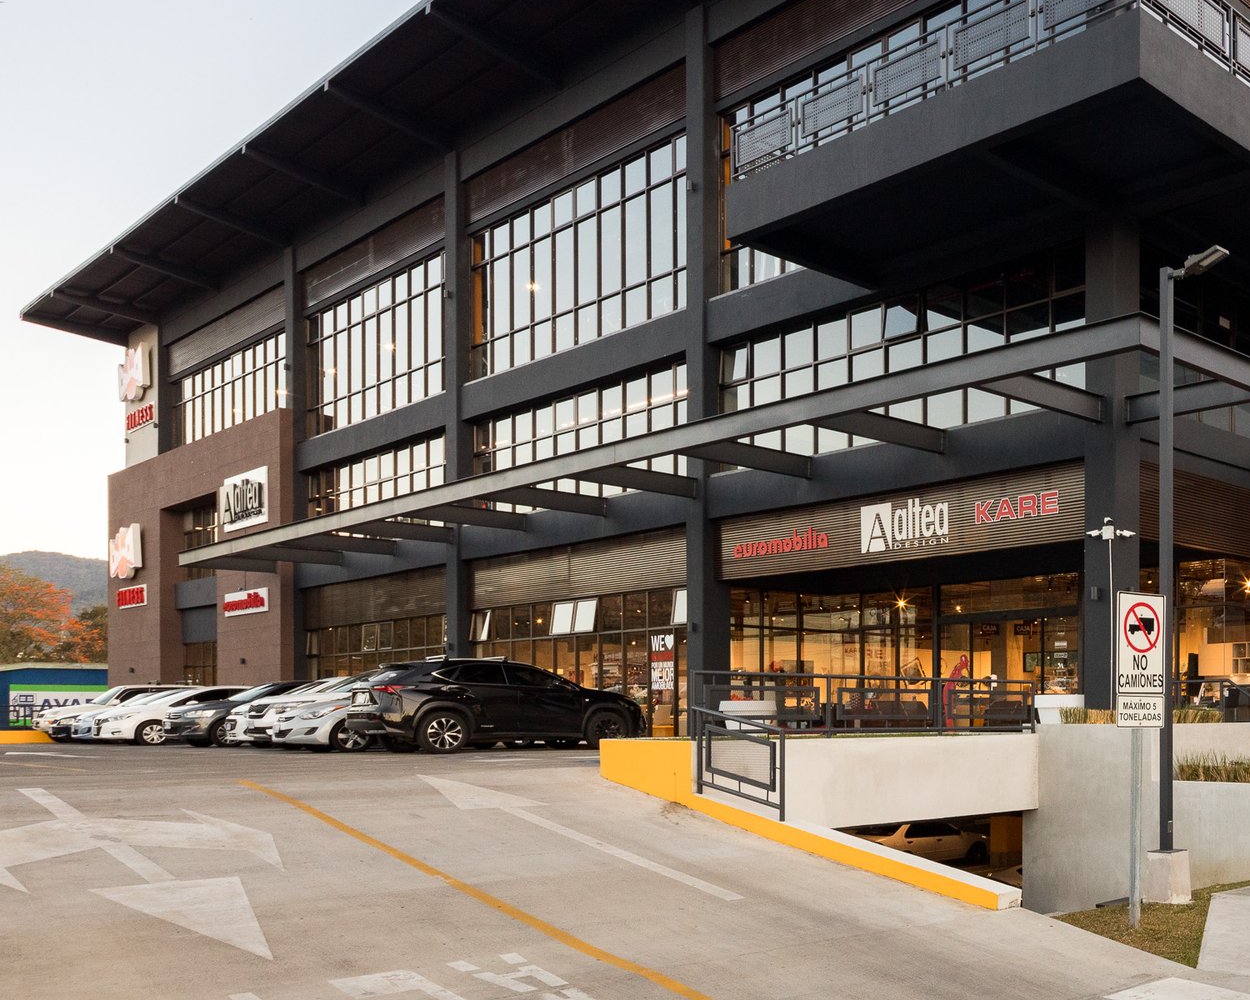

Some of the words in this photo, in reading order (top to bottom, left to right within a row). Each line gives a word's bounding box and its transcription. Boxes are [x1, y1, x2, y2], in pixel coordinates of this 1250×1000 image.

[975, 490, 1058, 524] KARE
[732, 526, 829, 558] euromobilia
[894, 536, 949, 550] DESIGN
[651, 635, 664, 651] WE
[1133, 655, 1148, 670] NO
[1119, 674, 1163, 687] CAMIONES
[1152, 702, 1157, 711] 5
[1120, 713, 1161, 721] TONELADAS
